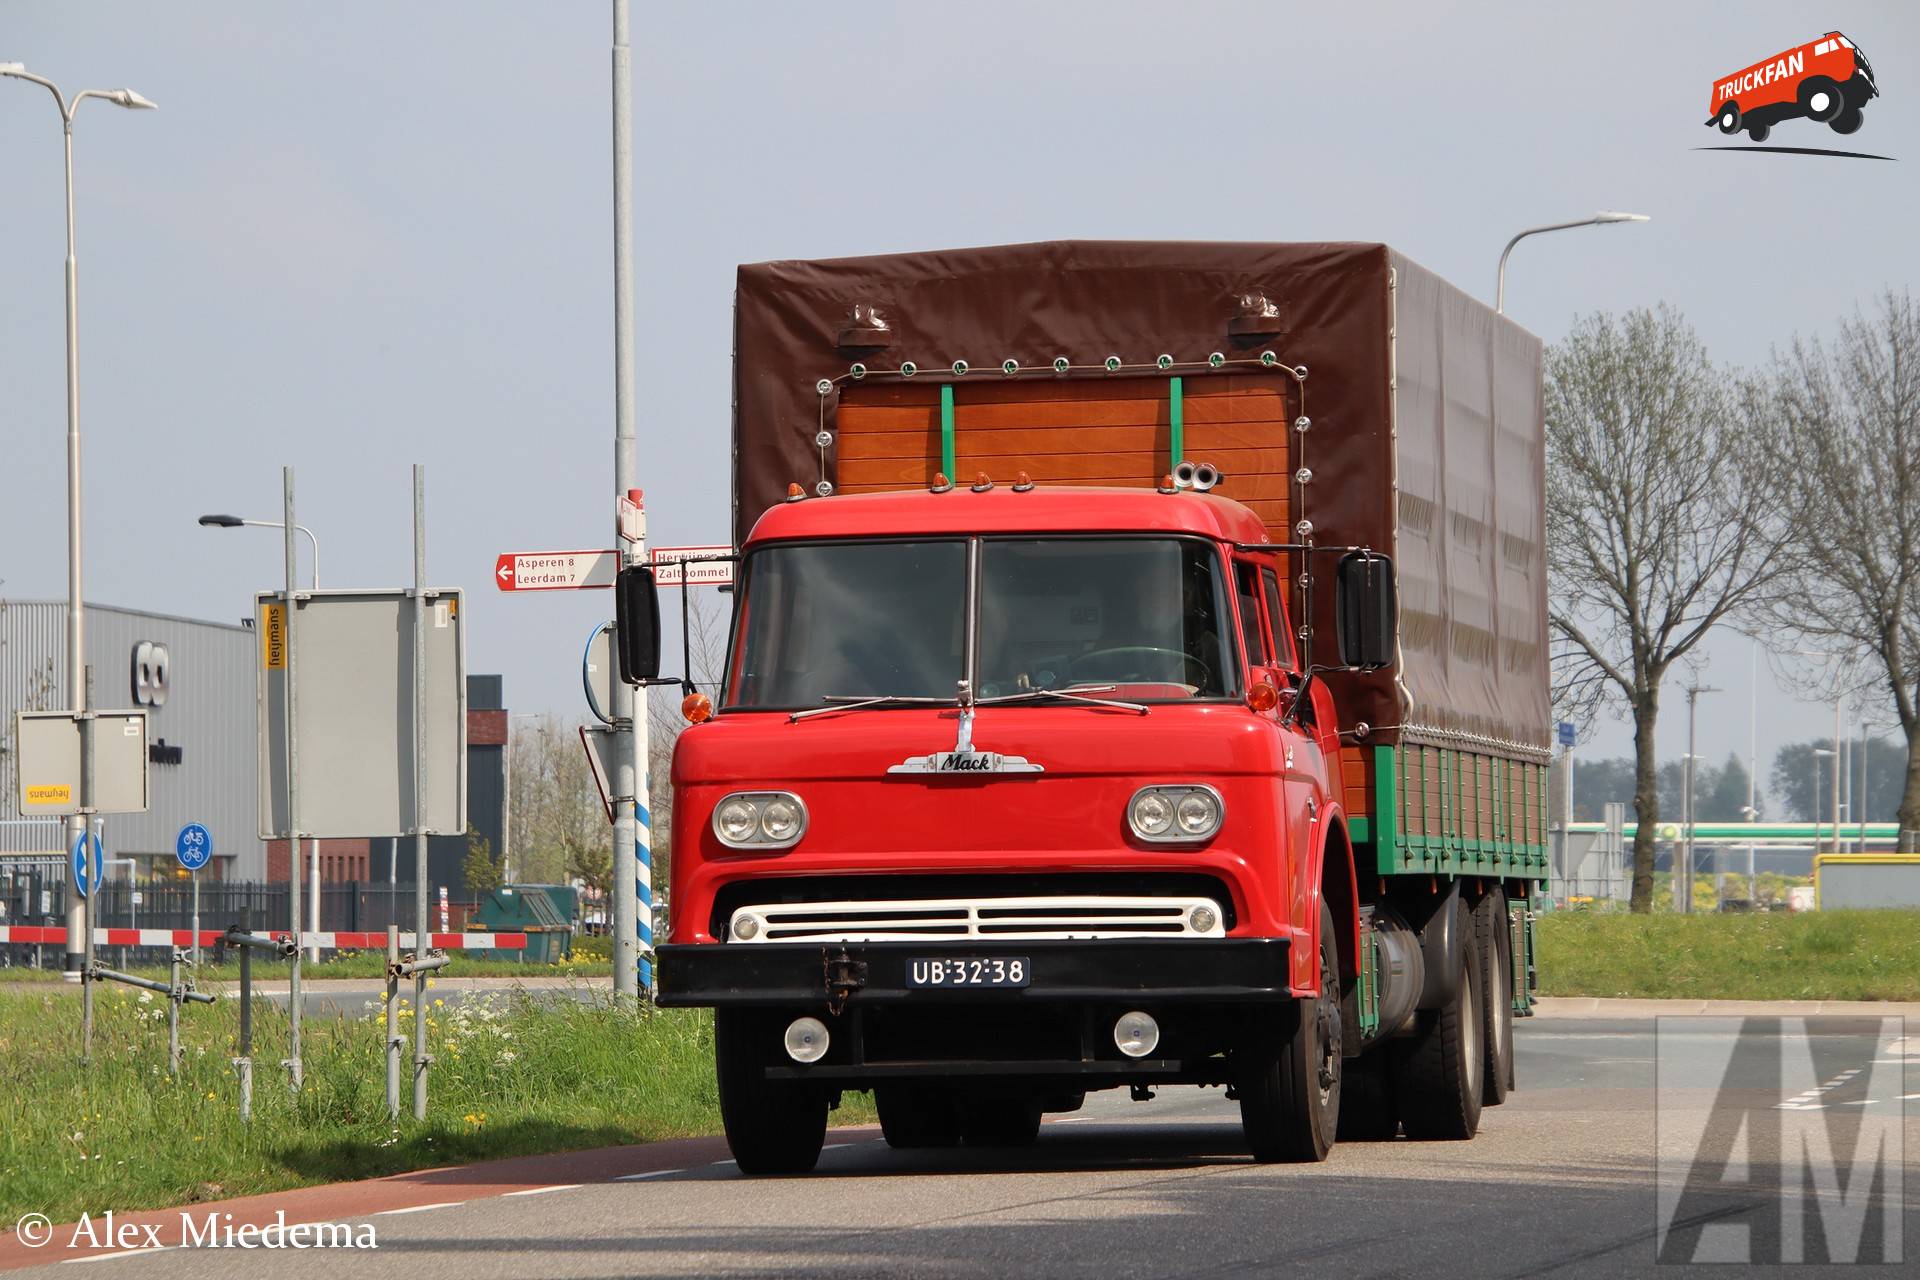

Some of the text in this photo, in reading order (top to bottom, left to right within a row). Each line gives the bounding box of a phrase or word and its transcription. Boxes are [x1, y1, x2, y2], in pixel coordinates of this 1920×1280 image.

[517, 558, 575, 570] Asperen 8
[517, 574, 576, 584] Leerdam 7
[659, 567, 729, 579] Zaltommel
[269, 608, 282, 666] heijmans
[941, 754, 990, 771] Mack
[28, 787, 69, 800] heijmans
